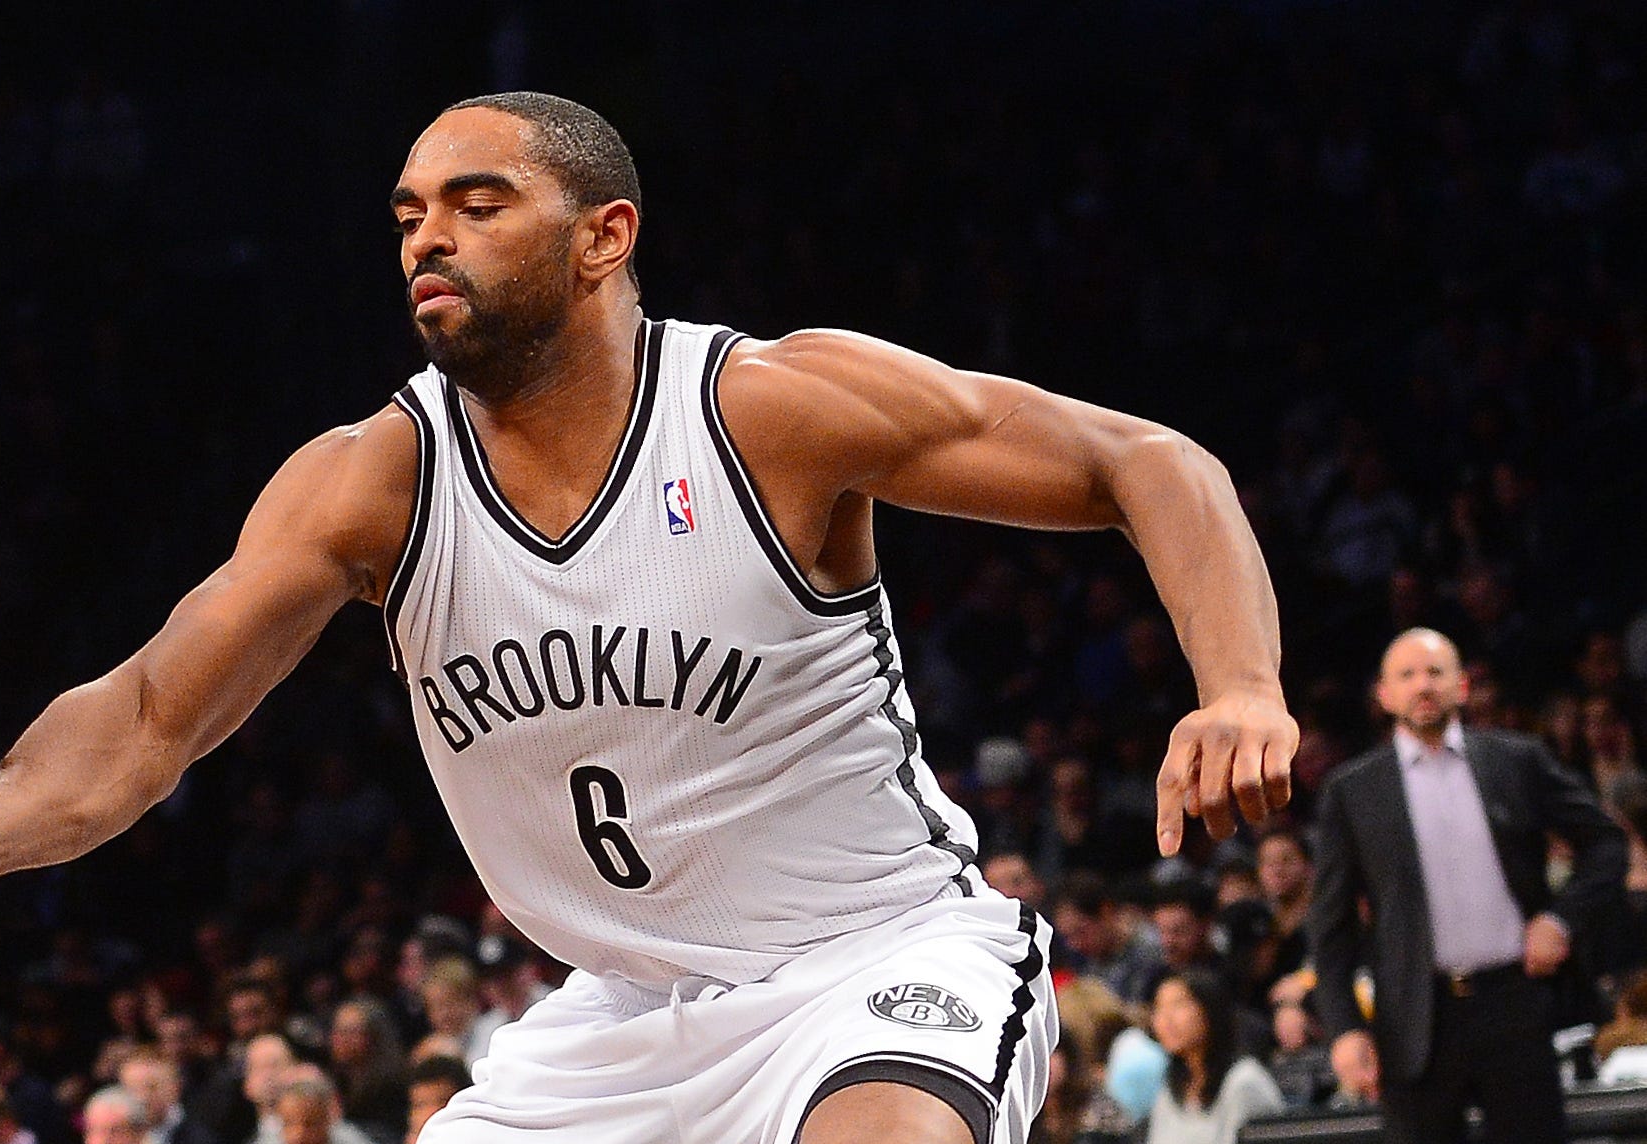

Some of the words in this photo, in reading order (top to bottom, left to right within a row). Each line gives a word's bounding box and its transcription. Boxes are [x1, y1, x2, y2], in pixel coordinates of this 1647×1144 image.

[419, 624, 762, 754] BROOKLYN
[568, 764, 652, 891] 6
[874, 984, 975, 1026] NETS
